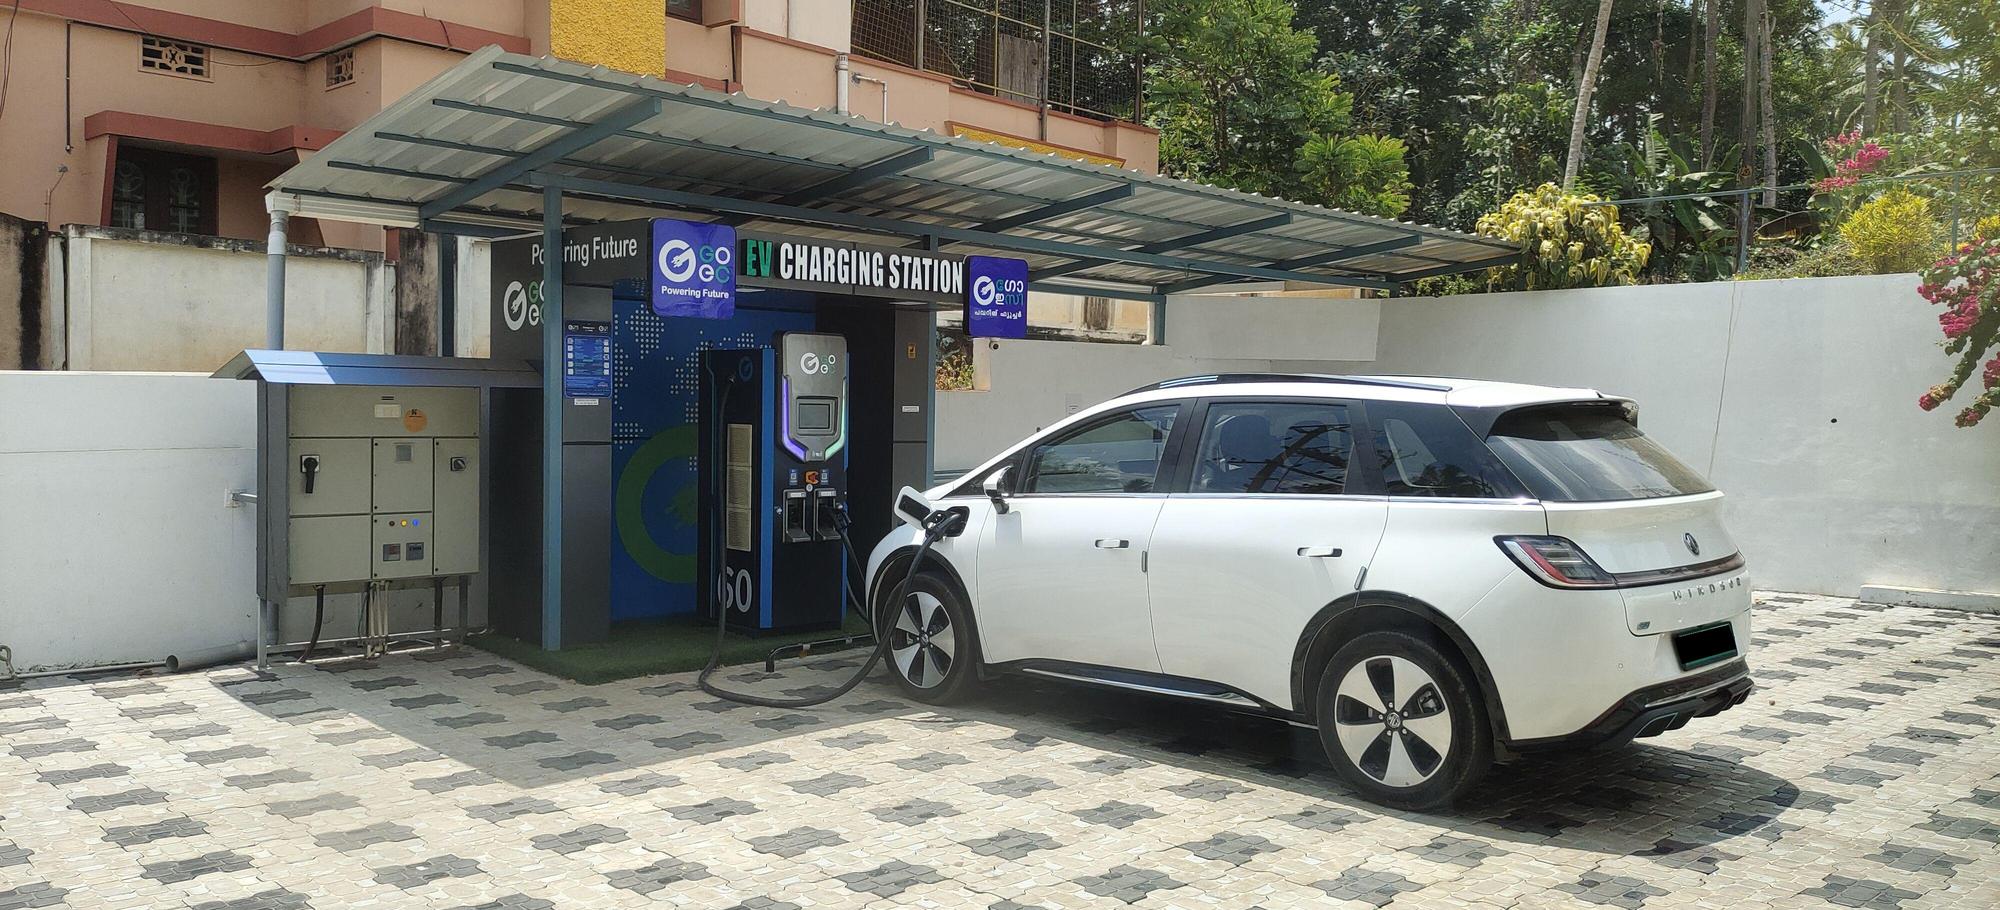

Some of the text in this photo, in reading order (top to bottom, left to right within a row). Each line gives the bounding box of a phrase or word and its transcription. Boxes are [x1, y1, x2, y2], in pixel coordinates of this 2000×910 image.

[593, 236, 638, 260] Future
[699, 245, 731, 265] GO
[746, 239, 963, 294] EV CHARGING STATION
[661, 285, 730, 299] Powering Future
[717, 566, 752, 613] 60
